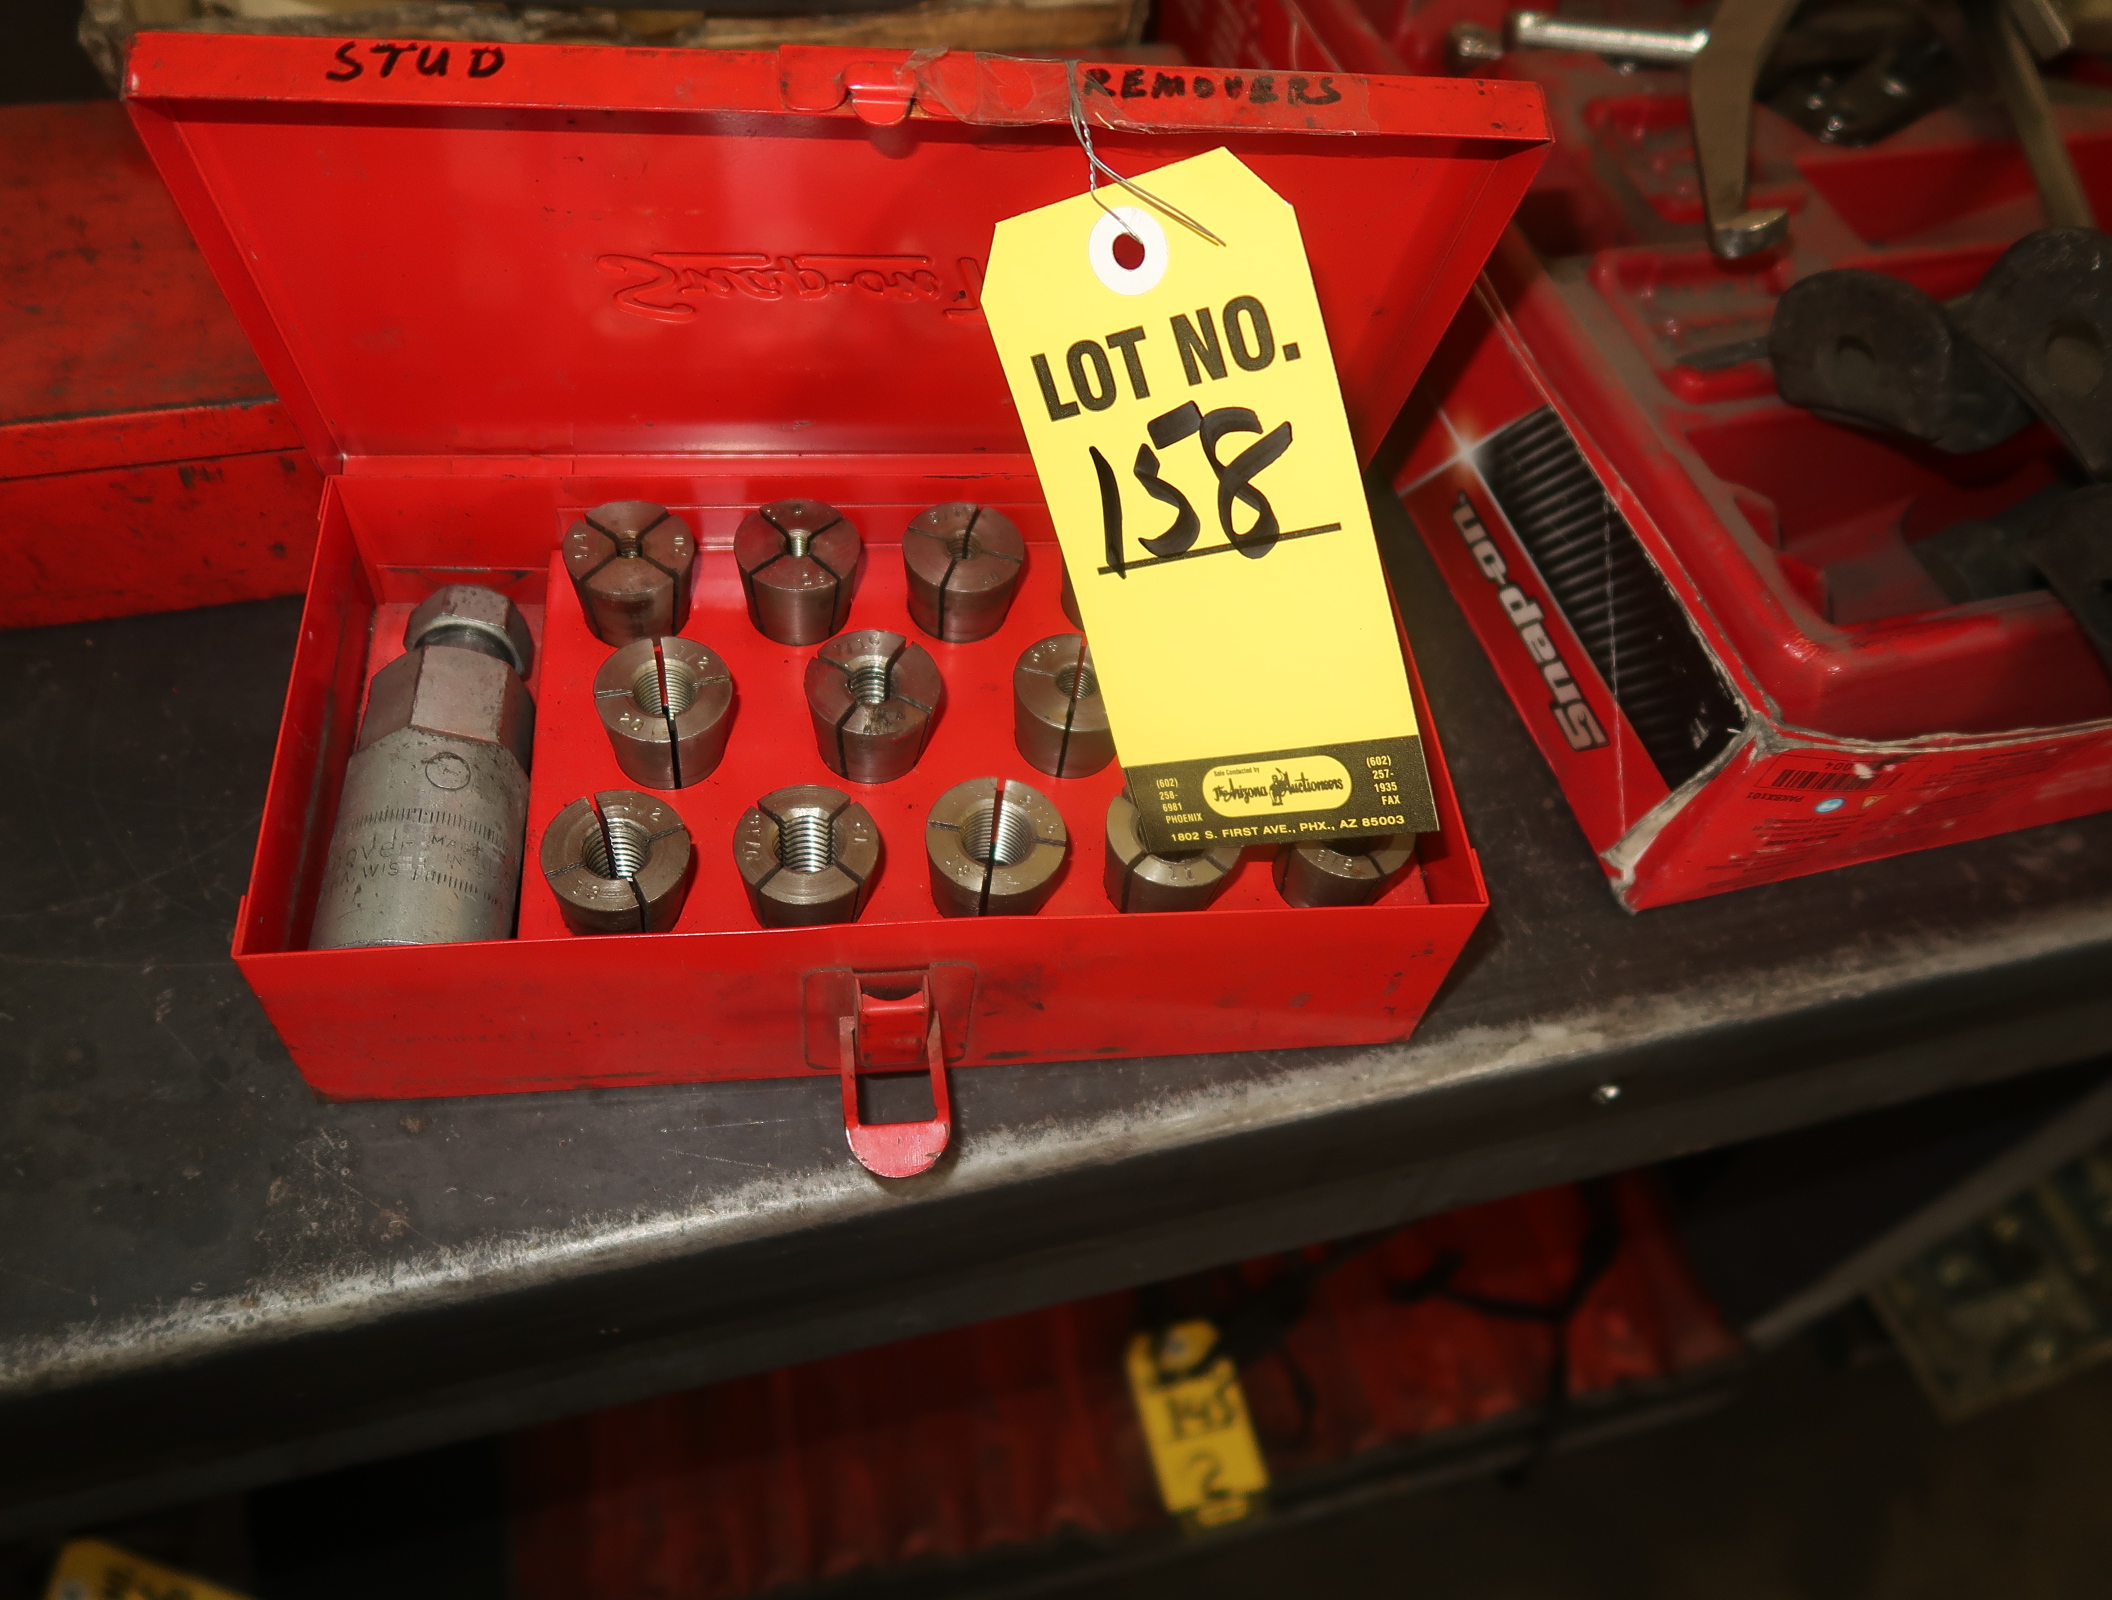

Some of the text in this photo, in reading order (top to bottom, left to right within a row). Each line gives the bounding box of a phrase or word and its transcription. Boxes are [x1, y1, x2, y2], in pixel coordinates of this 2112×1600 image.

[326, 40, 506, 82] STUD
[1083, 67, 1342, 105] REMOVERS
[1030, 294, 1302, 422] LOT NO.
[1088, 400, 1293, 580] 158
[1366, 754, 1392, 769] (602)
[1226, 767, 1253, 776] Conducted
[1371, 768, 1395, 780] 257-
[1156, 777, 1179, 790] (602)
[1373, 781, 1398, 793] 1935
[1159, 790, 1179, 801] 258-
[1381, 794, 1402, 806] FAX
[1162, 802, 1183, 813] 6981
[1165, 812, 1204, 825] PHOENIX
[1170, 815, 1405, 843] 1802 S. FIRST AVE., PHX., AZ 85003
